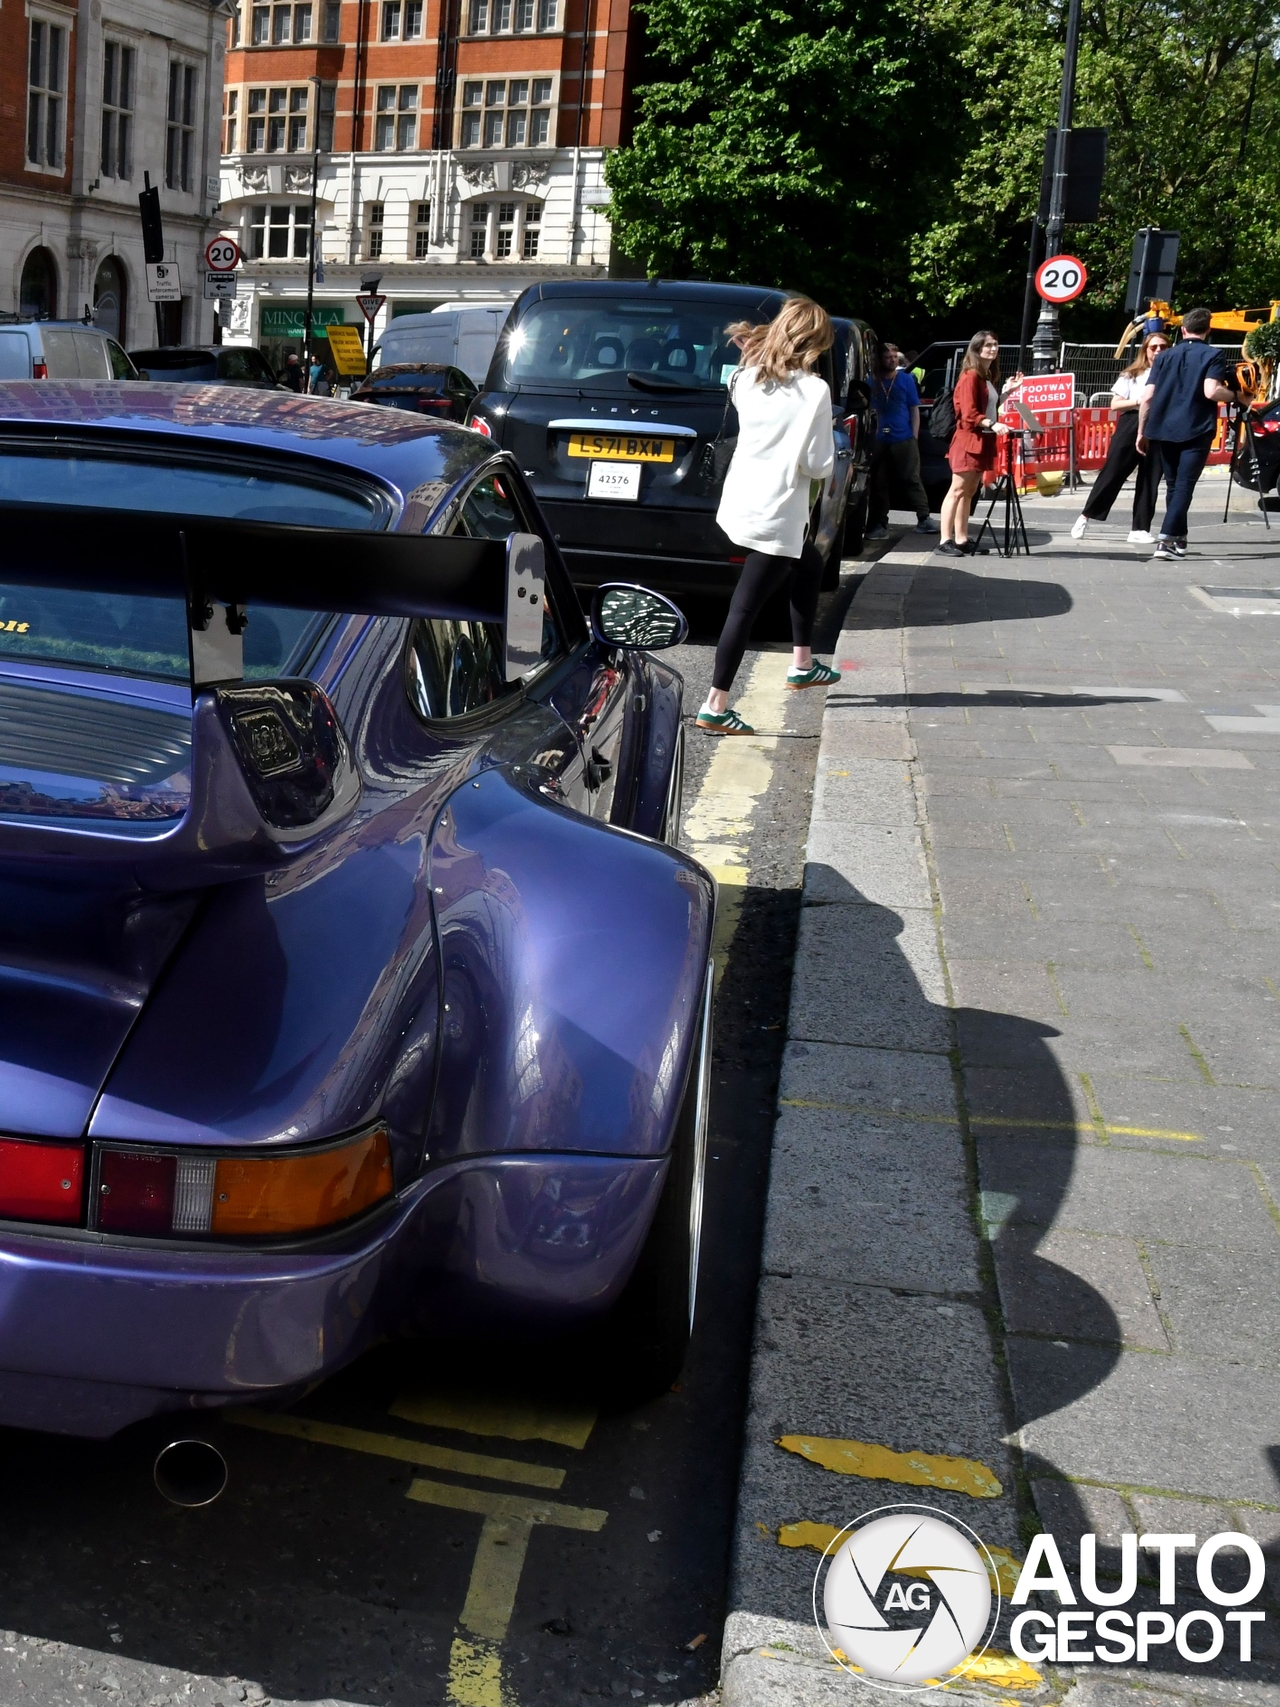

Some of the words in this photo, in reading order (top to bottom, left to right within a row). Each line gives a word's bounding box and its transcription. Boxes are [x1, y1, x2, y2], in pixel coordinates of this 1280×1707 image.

[211, 247, 234, 262] 20
[1044, 269, 1079, 289] 20
[1022, 382, 1071, 394] FOOTWAY
[1028, 392, 1066, 403] CLOSED
[590, 406, 659, 415] LEVC
[580, 436, 621, 455] LS71
[625, 437, 663, 457] BXW
[598, 475, 629, 485] 42576
